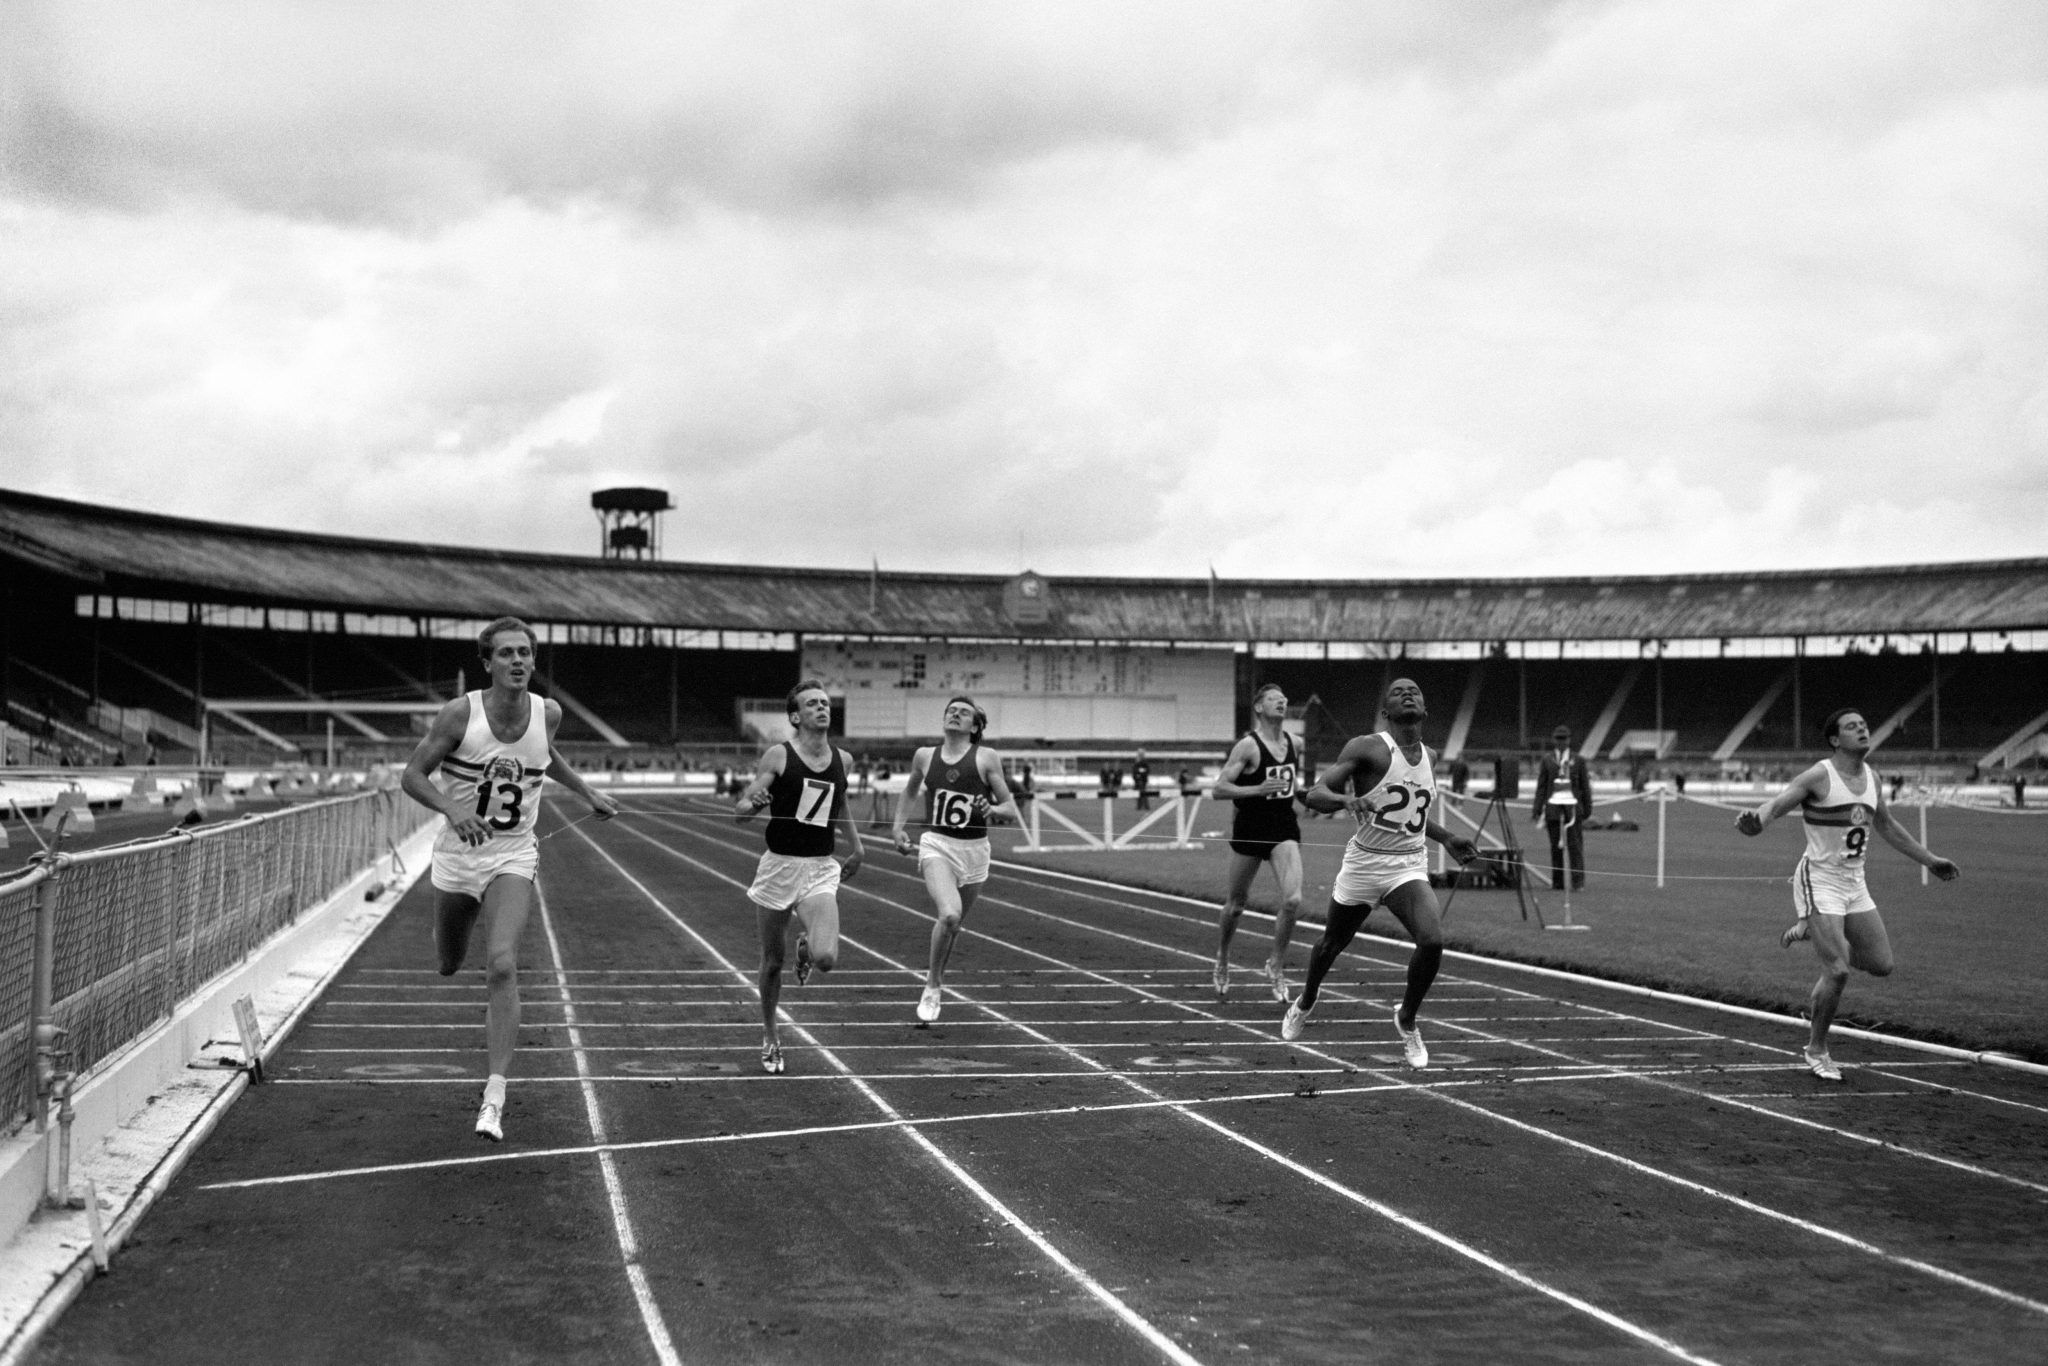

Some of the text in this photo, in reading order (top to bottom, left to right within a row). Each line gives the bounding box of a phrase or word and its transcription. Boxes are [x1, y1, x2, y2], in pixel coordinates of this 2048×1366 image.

[475, 780, 523, 831] 13
[806, 779, 831, 822] 7
[935, 790, 969, 827] 16
[1373, 784, 1431, 833] 23
[1846, 826, 1866, 859] 9
